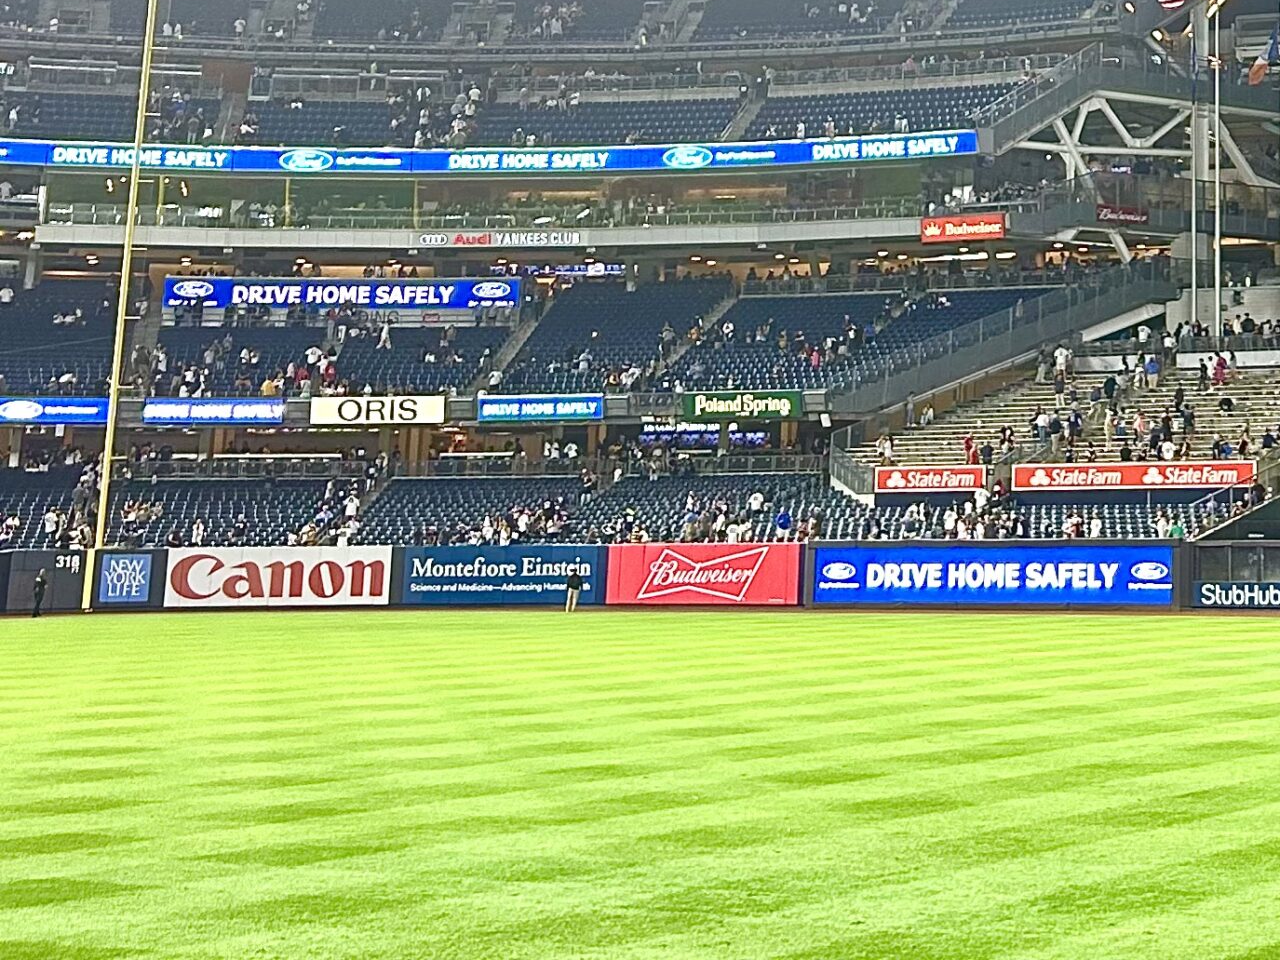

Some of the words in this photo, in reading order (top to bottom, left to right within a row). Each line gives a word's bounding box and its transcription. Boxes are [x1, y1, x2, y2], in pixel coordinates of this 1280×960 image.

[53, 146, 108, 163] DRIVE
[111, 149, 162, 165] HOME
[164, 151, 228, 167] SAFELY
[812, 143, 859, 160] DRIVE
[862, 140, 905, 158] HOME
[908, 136, 959, 156] SAFELY
[449, 154, 499, 169] DRIVE
[501, 154, 549, 169] HOME
[551, 152, 609, 169] SAFELY
[453, 232, 492, 246] Audi
[496, 232, 548, 246] YANKEES
[550, 232, 581, 246] CLUB
[232, 285, 301, 304] DRIVE
[306, 285, 371, 304] HOME
[374, 285, 455, 304] SAFELY
[337, 398, 418, 422] ORIS
[695, 395, 743, 415] Poland
[742, 394, 791, 415] Spring
[55, 555, 80, 569] 318
[110, 559, 144, 572] NEW
[411, 557, 516, 577] Montefiore
[521, 557, 591, 576] Einstein
[651, 555, 754, 585] Budweiser
[104, 570, 146, 585] YORK
[170, 554, 385, 599] Canon
[866, 562, 943, 589] DRIVE
[947, 562, 1021, 589] HOME
[1025, 562, 1119, 589] SAFELY
[107, 583, 141, 597] LIFE
[410, 583, 441, 591] Science
[442, 583, 456, 591] and
